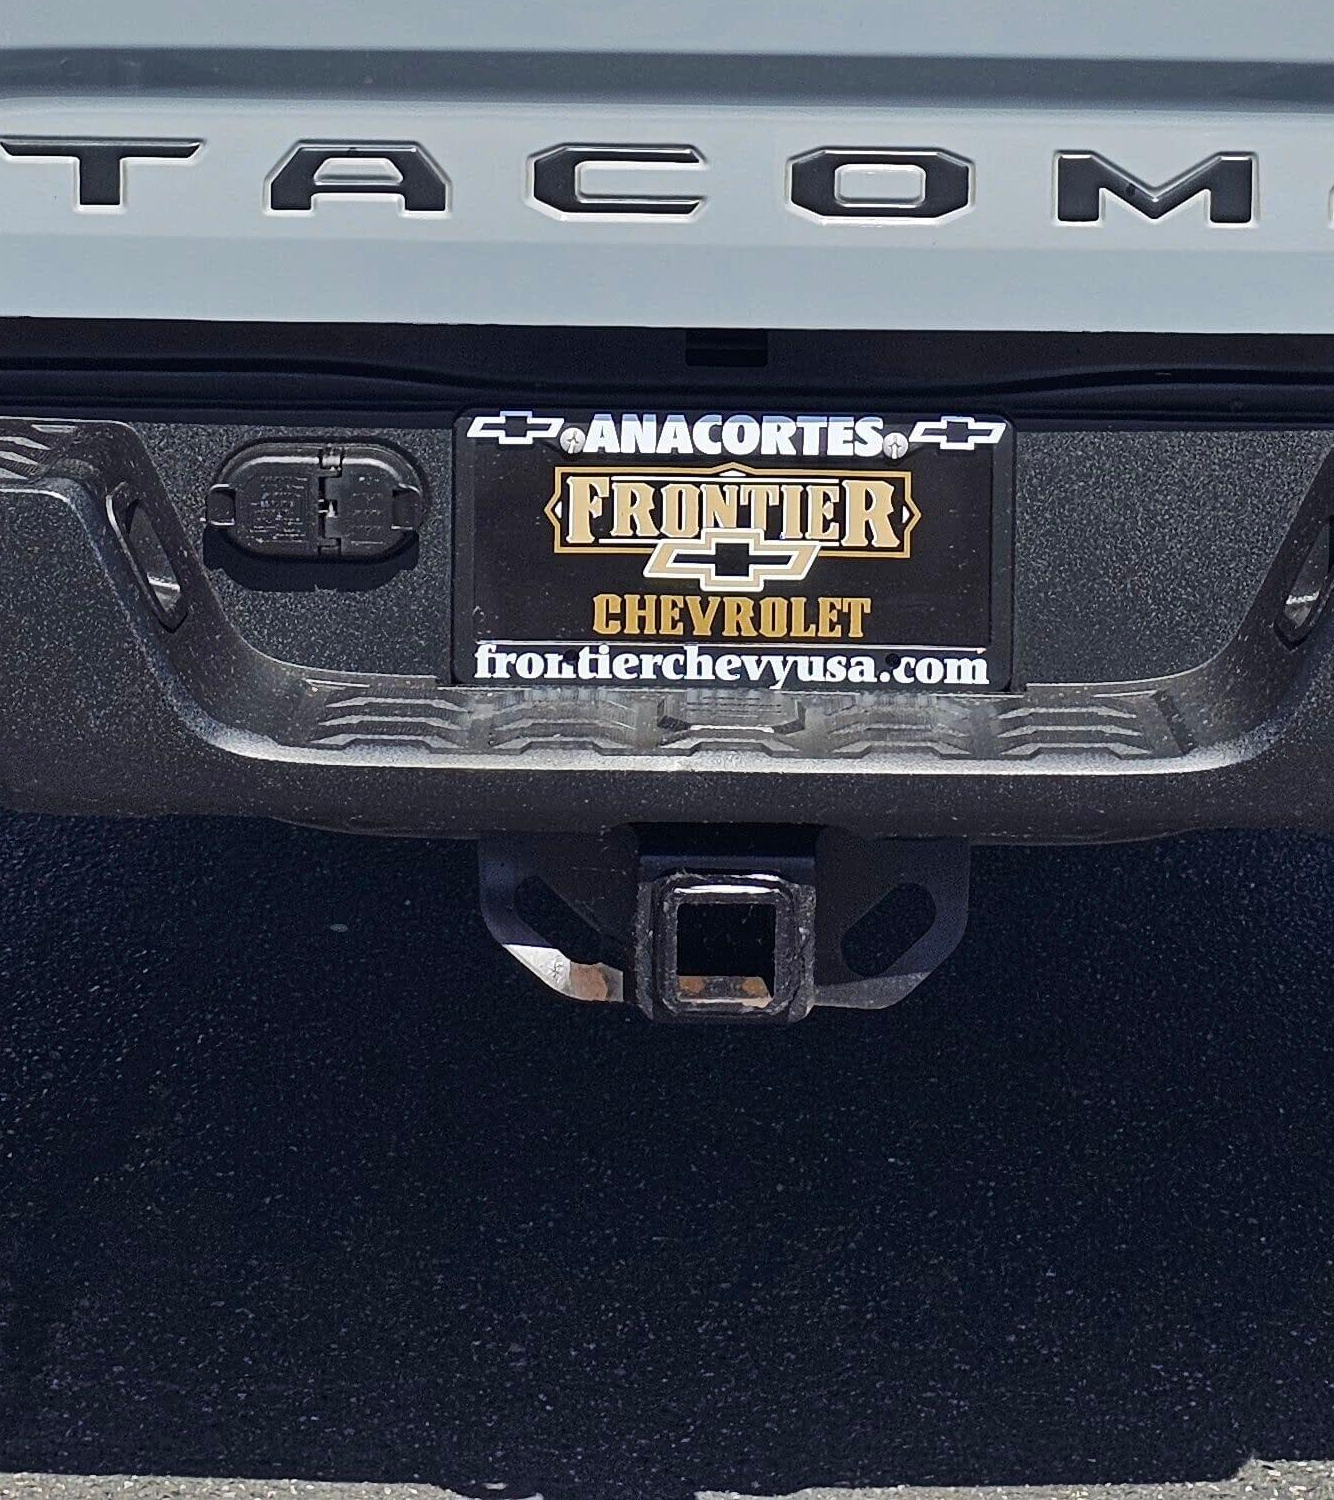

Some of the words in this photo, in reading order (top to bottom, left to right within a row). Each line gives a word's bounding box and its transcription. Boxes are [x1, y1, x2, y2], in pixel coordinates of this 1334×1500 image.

[582, 414, 884, 457] ANACORTES
[566, 476, 902, 550] FRONTIER
[593, 593, 872, 638] CHEVROLET
[474, 645, 990, 690] frontierchevyusa.com
